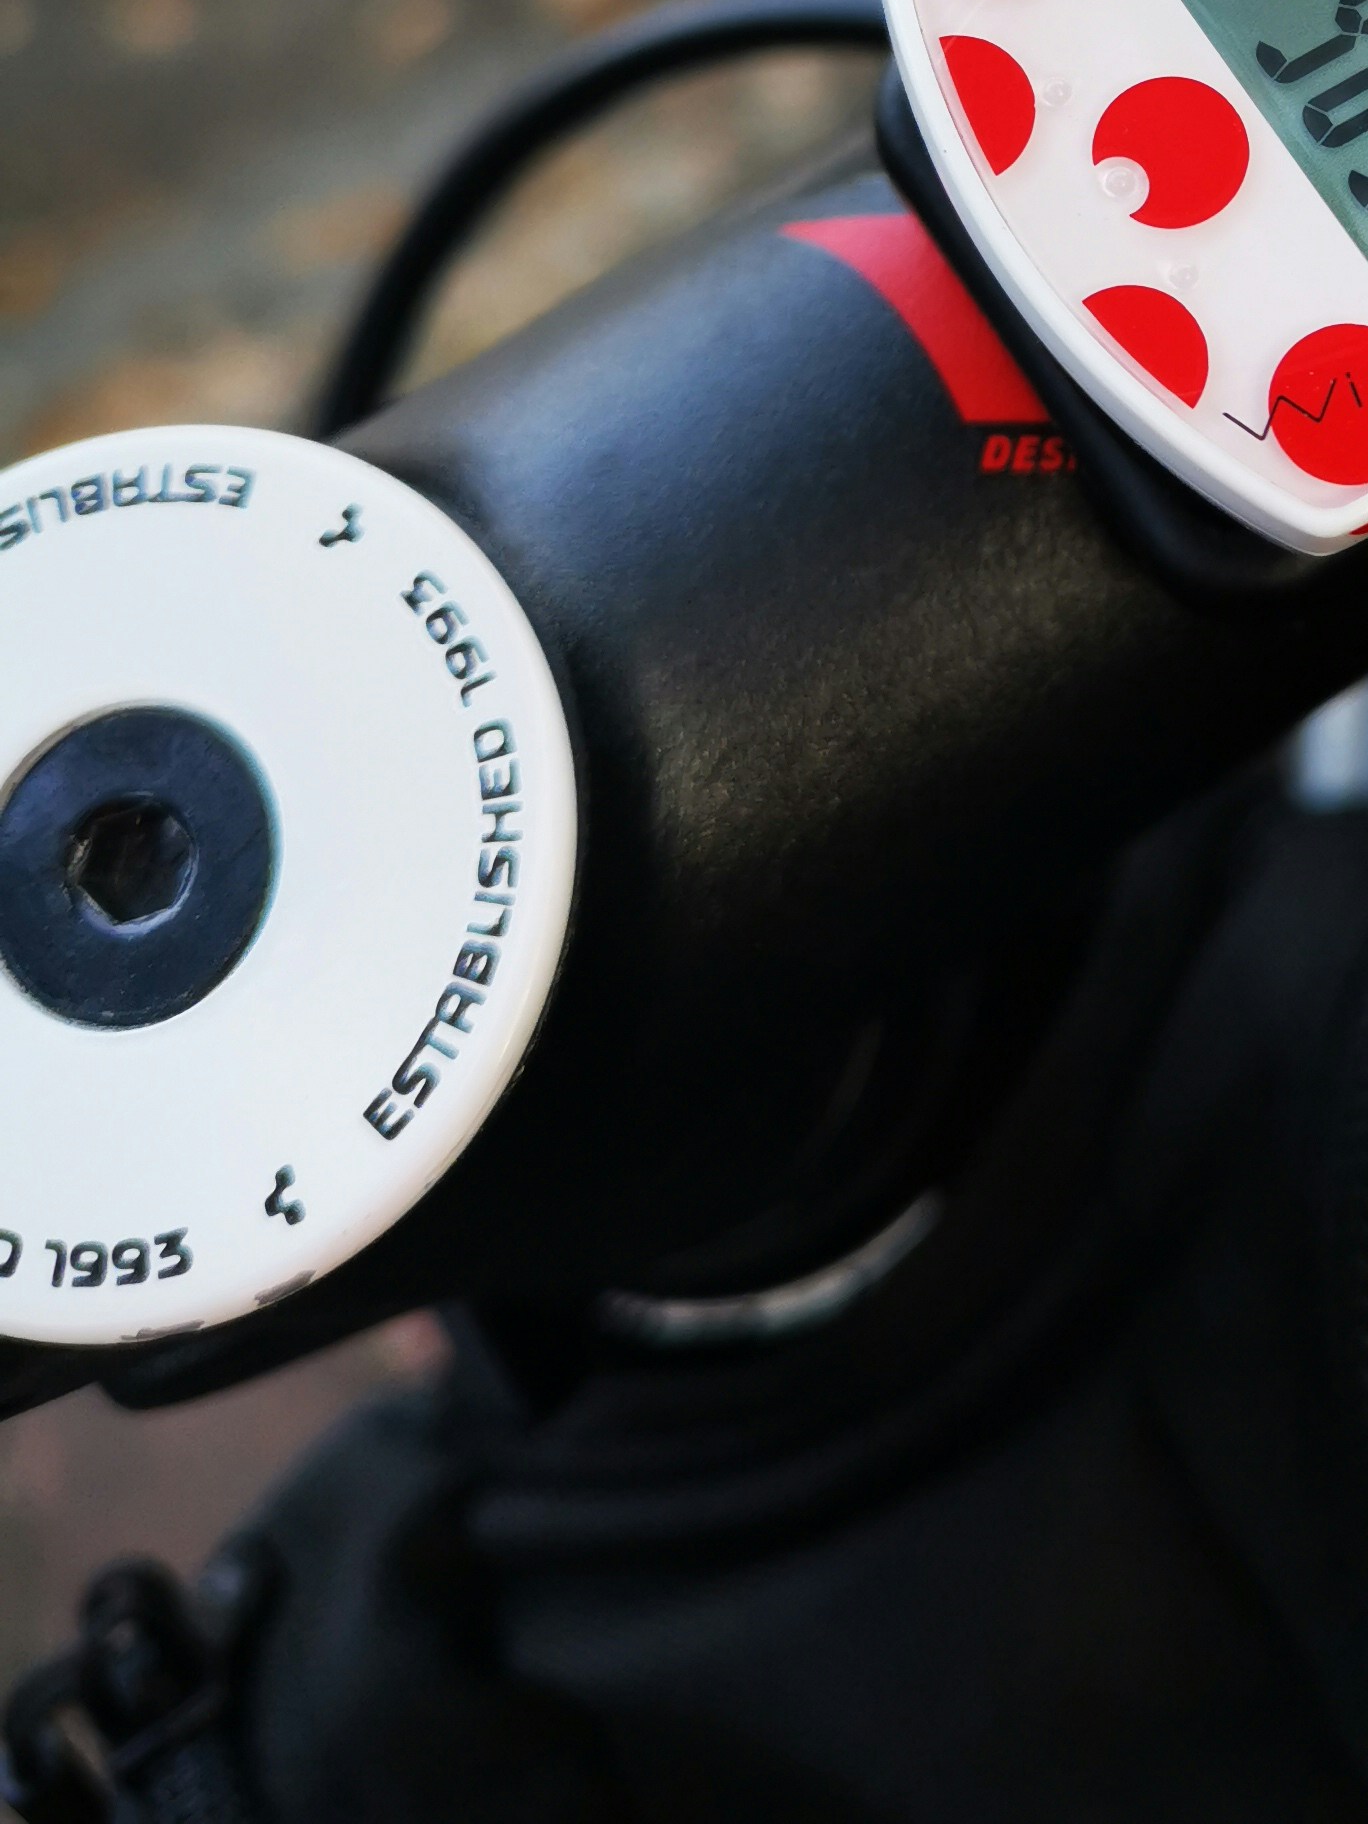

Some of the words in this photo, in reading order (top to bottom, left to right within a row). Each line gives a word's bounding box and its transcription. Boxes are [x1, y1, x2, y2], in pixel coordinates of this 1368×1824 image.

[400, 569, 497, 709] 1993
[362, 717, 522, 1142] ESTABLISHED
[45, 1226, 194, 1288] 1993
